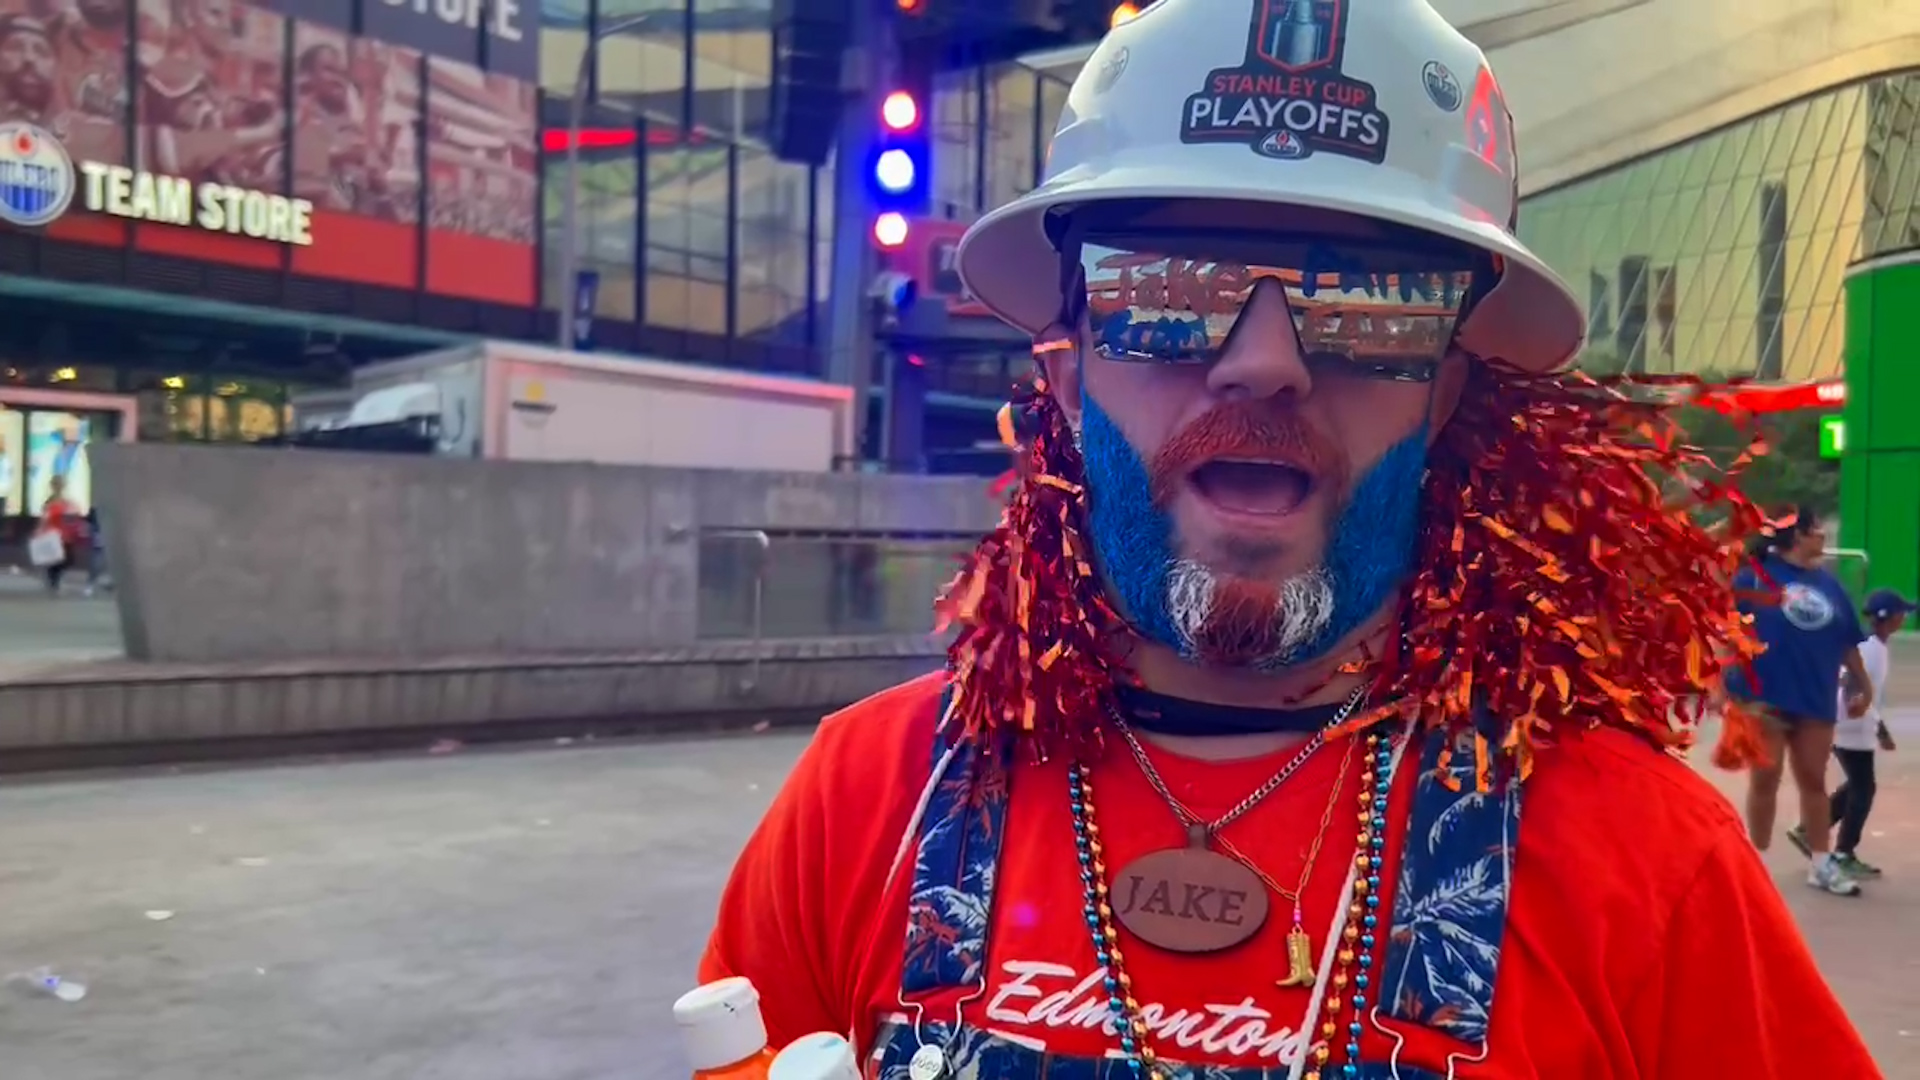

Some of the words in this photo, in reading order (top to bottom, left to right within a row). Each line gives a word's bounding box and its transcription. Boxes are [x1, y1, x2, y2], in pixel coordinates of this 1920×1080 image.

[1213, 74, 1317, 97] STANLEY
[1322, 82, 1367, 106] CUP
[1190, 97, 1381, 145] PLAYOFFS
[81, 160, 192, 226] TEAM
[197, 182, 313, 245] STORE
[1121, 876, 1247, 926] JAKE
[986, 960, 1317, 1060] Edmonton
